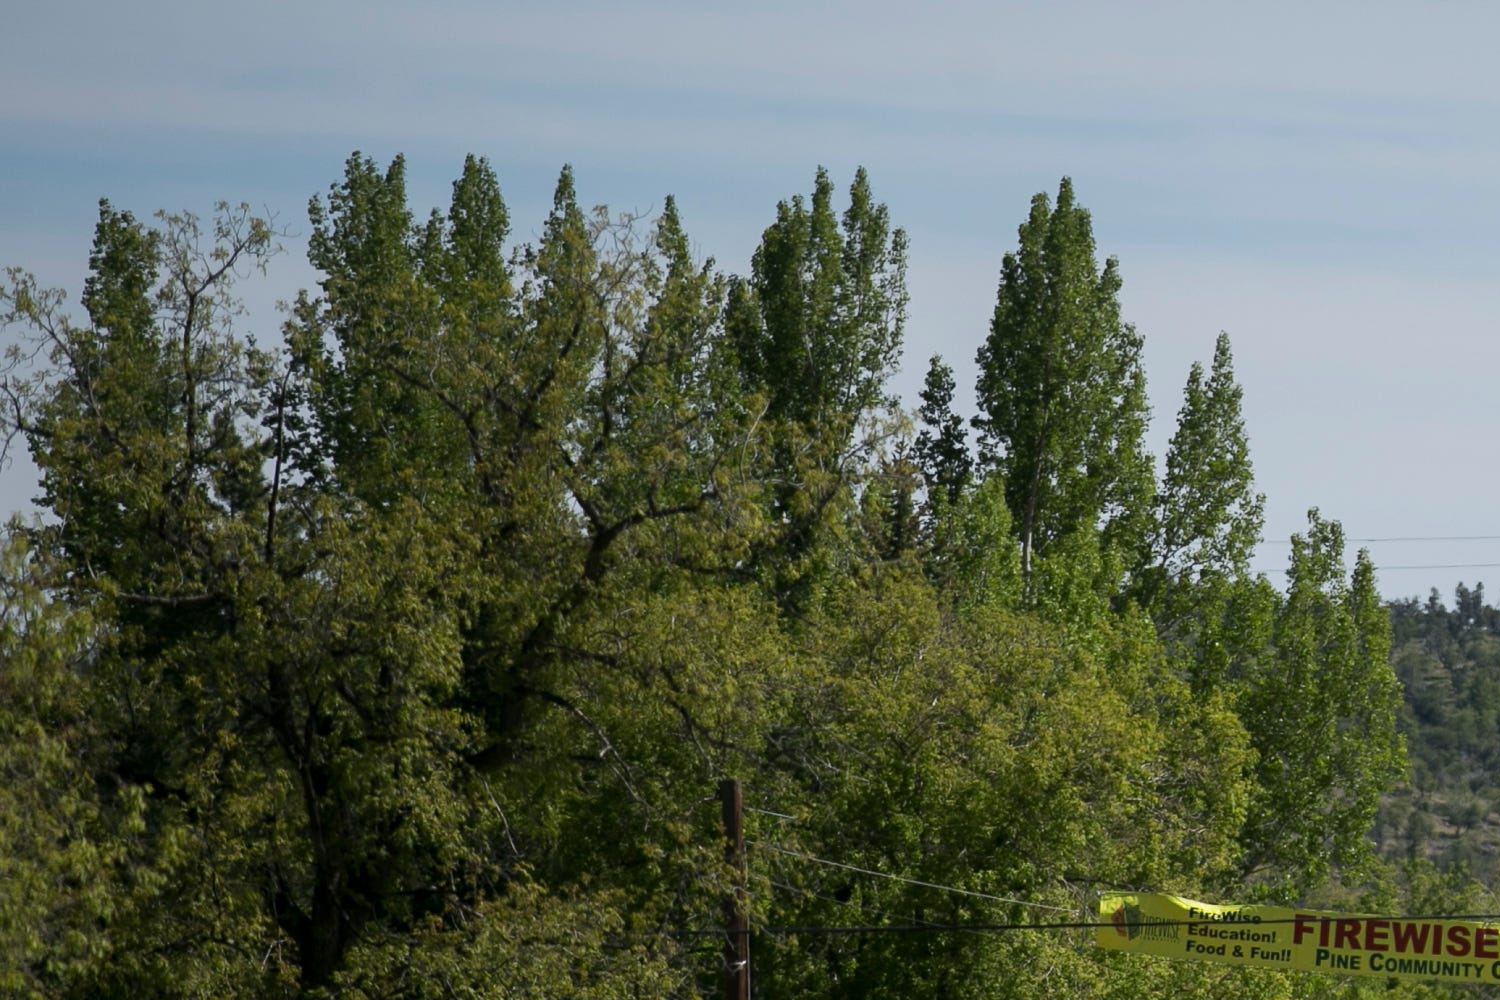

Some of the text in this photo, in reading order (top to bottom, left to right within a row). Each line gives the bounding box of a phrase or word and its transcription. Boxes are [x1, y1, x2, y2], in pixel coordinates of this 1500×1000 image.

[1188, 907, 1262, 924] FireWise
[1187, 923, 1277, 944] Education!
[1293, 914, 1500, 959] FIREWISE
[1186, 940, 1226, 957] Food
[1232, 945, 1244, 958] &
[1250, 947, 1291, 962] Fun!!
[1369, 952, 1483, 979] COMMUNITY
